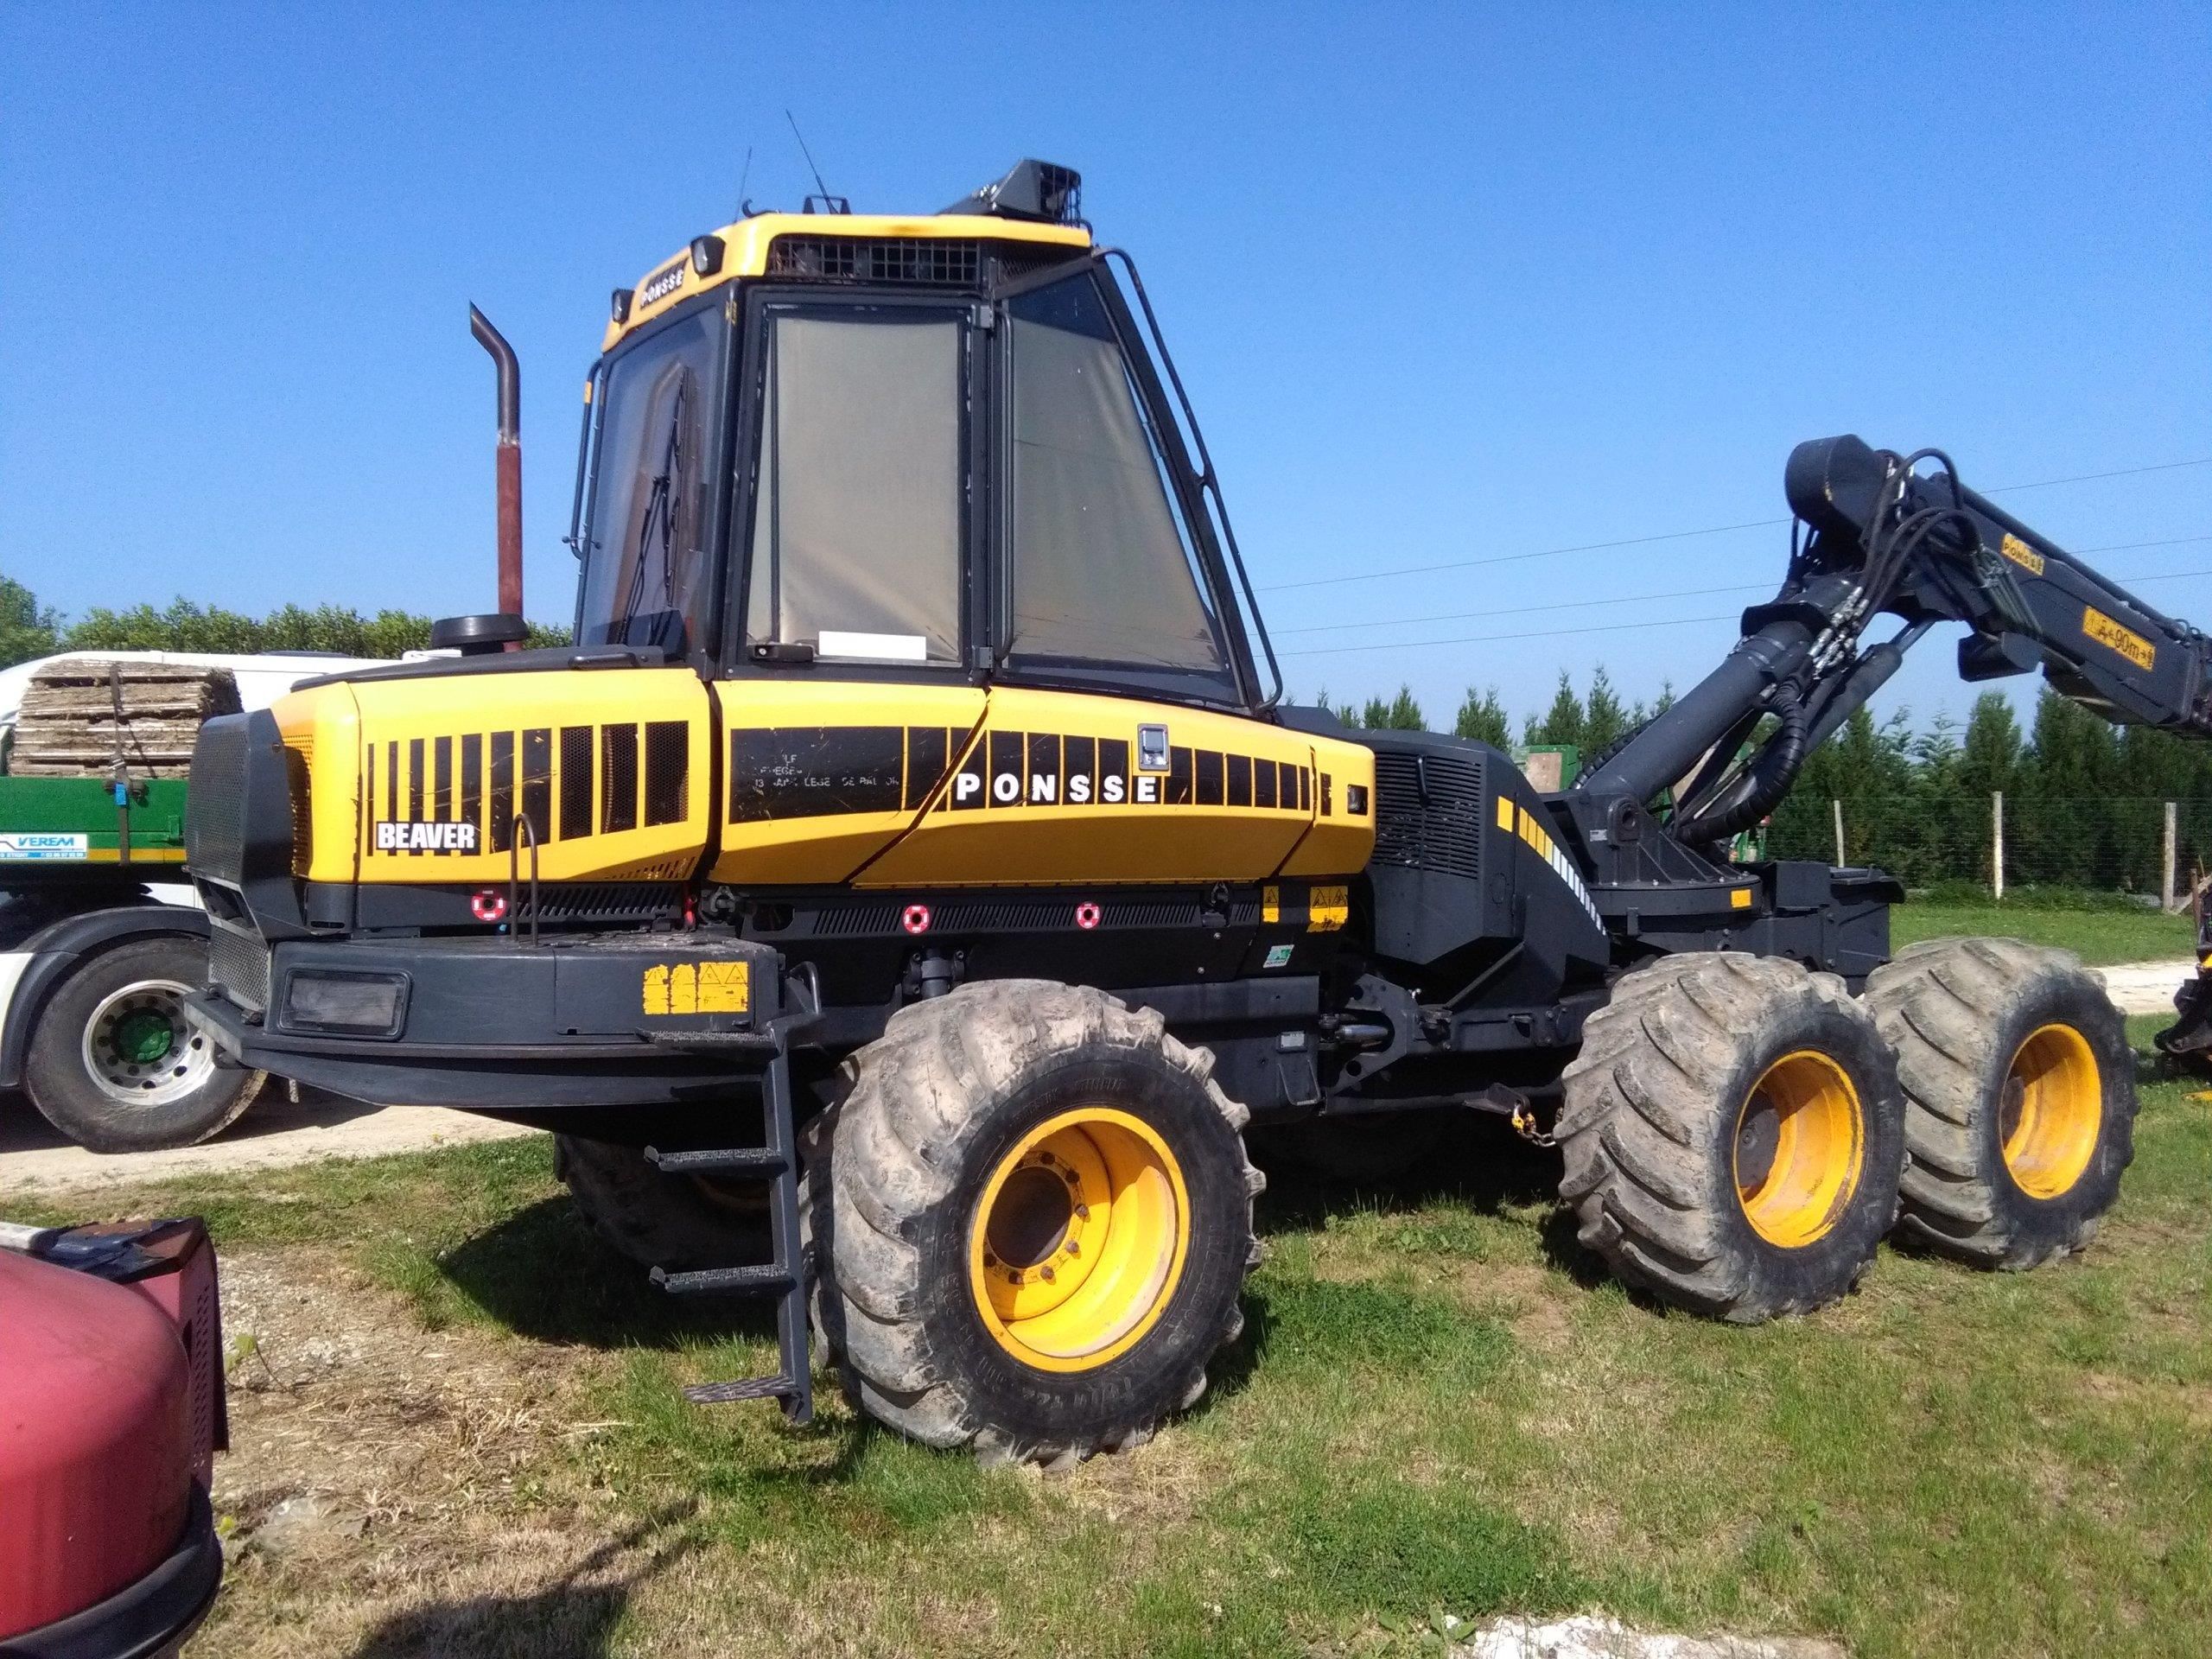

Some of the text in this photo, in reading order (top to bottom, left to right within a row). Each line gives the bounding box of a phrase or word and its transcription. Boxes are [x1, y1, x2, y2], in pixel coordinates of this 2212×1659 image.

[641, 269, 684, 307] PONSSE
[2004, 542, 2043, 574] PONSSE
[957, 772, 1156, 802] PONSSE
[18, 836, 75, 847] VEREM
[378, 823, 475, 849] BEAVER
